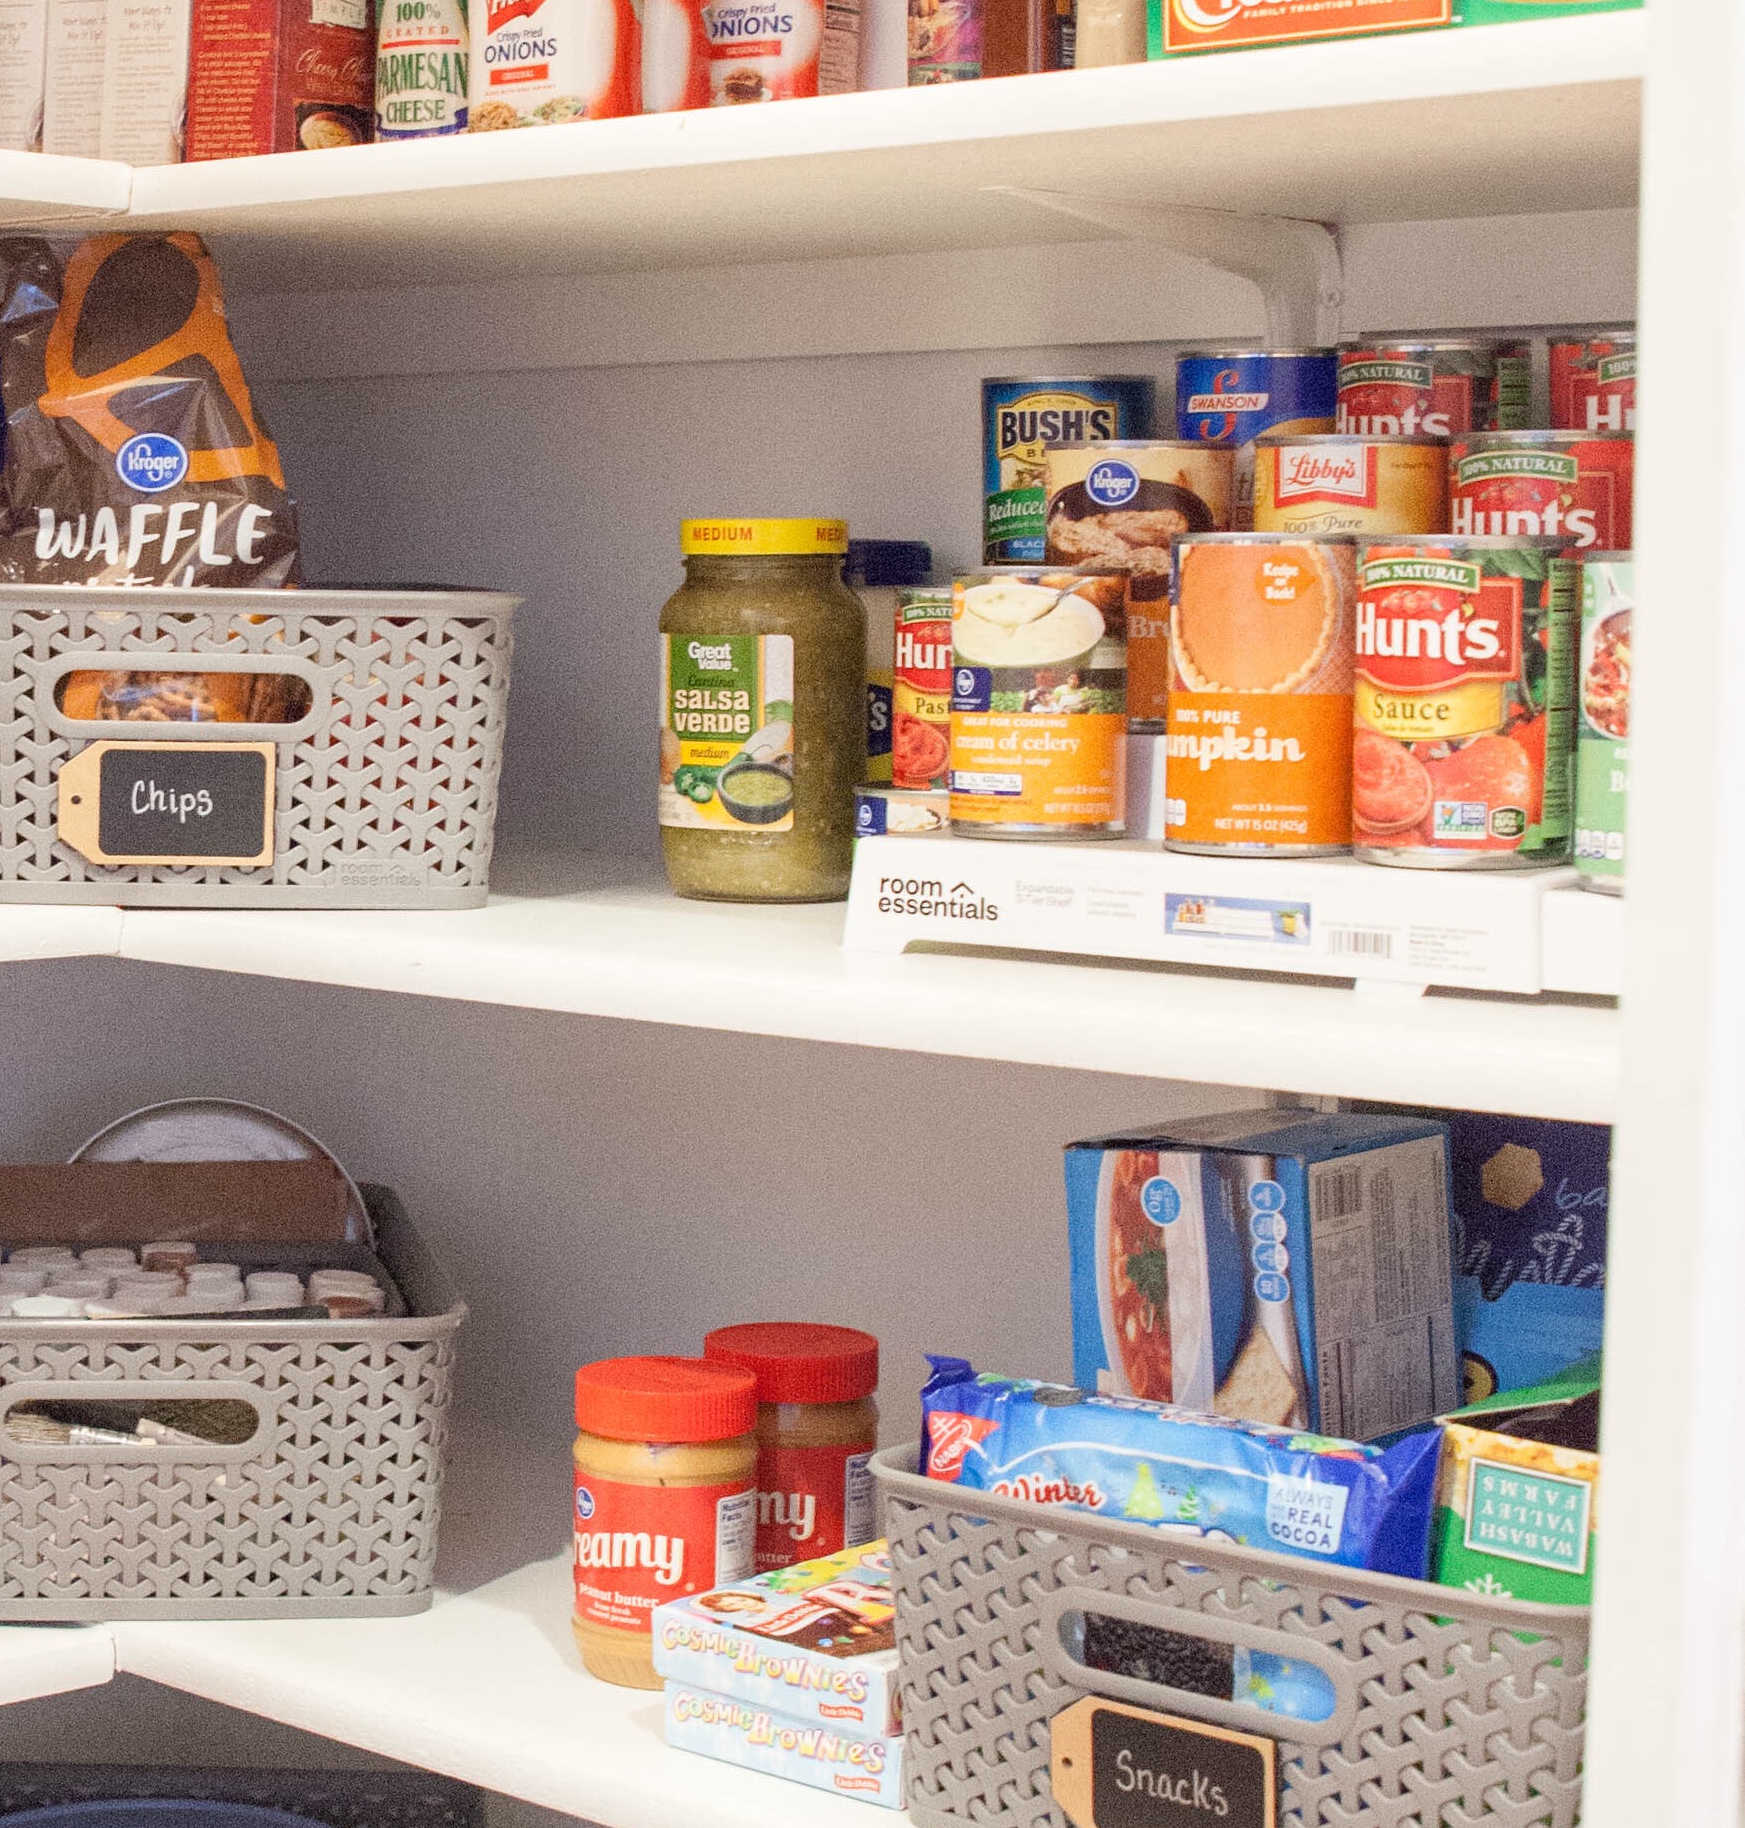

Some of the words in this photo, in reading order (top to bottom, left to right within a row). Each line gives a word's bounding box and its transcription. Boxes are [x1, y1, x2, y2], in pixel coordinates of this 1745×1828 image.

[396, 1, 442, 23] 100%
[718, 6, 748, 21] Crispy
[750, 3, 776, 16] Fried
[1243, 7, 1287, 20] FAMILY
[1289, 1, 1353, 15] TRADITION
[386, 25, 450, 40] GRATED
[497, 29, 524, 44] Crispy
[526, 26, 543, 41] Fried
[484, 38, 557, 64] ONIONS
[378, 52, 470, 99] PARMESAN
[386, 99, 446, 124] CHEESE
[1360, 365, 1424, 382] NATURAL
[1190, 395, 1260, 412] SWANSON
[1002, 409, 1114, 451] BUSH'S
[128, 443, 180, 482] Kroger
[1287, 453, 1356, 485] Libby's
[1492, 457, 1567, 473] NATURAL
[1094, 468, 1134, 498] Kroger
[1323, 516, 1363, 532] Pure
[1452, 495, 1597, 548] Hunt's
[35, 502, 273, 569] WAFFLE
[693, 527, 753, 542] MEDIUM
[1262, 562, 1299, 578] Recipe
[1393, 563, 1469, 584] NATURAL
[1356, 601, 1500, 666] Hunt's
[688, 641, 732, 660] Great
[697, 657, 732, 671] Value
[1203, 709, 1241, 724] PURE
[1373, 693, 1452, 722] Sauce
[1012, 717, 1067, 729] COOKING
[690, 747, 730, 761] medium
[956, 735, 995, 751] cream
[998, 731, 1020, 751] of
[1022, 732, 1080, 755] celery
[1166, 726, 1306, 771] mpkin
[131, 779, 214, 824] Chips
[878, 875, 943, 898] room
[1015, 879, 1076, 898] Expandable
[878, 895, 1000, 922] essentials
[993, 1476, 1105, 1509] Winter
[1274, 1488, 1334, 1510] ALWAYS
[1482, 1474, 1579, 1512] FARMS
[1288, 1508, 1334, 1530] REAL
[1480, 1499, 1577, 1535] VALLEY
[1271, 1522, 1333, 1550] COCOA
[1479, 1523, 1575, 1559] WABASH
[574, 1531, 683, 1585] reamy
[579, 1581, 611, 1603] peanut
[614, 1590, 659, 1609] butter
[1116, 1749, 1229, 1817] Snacks
